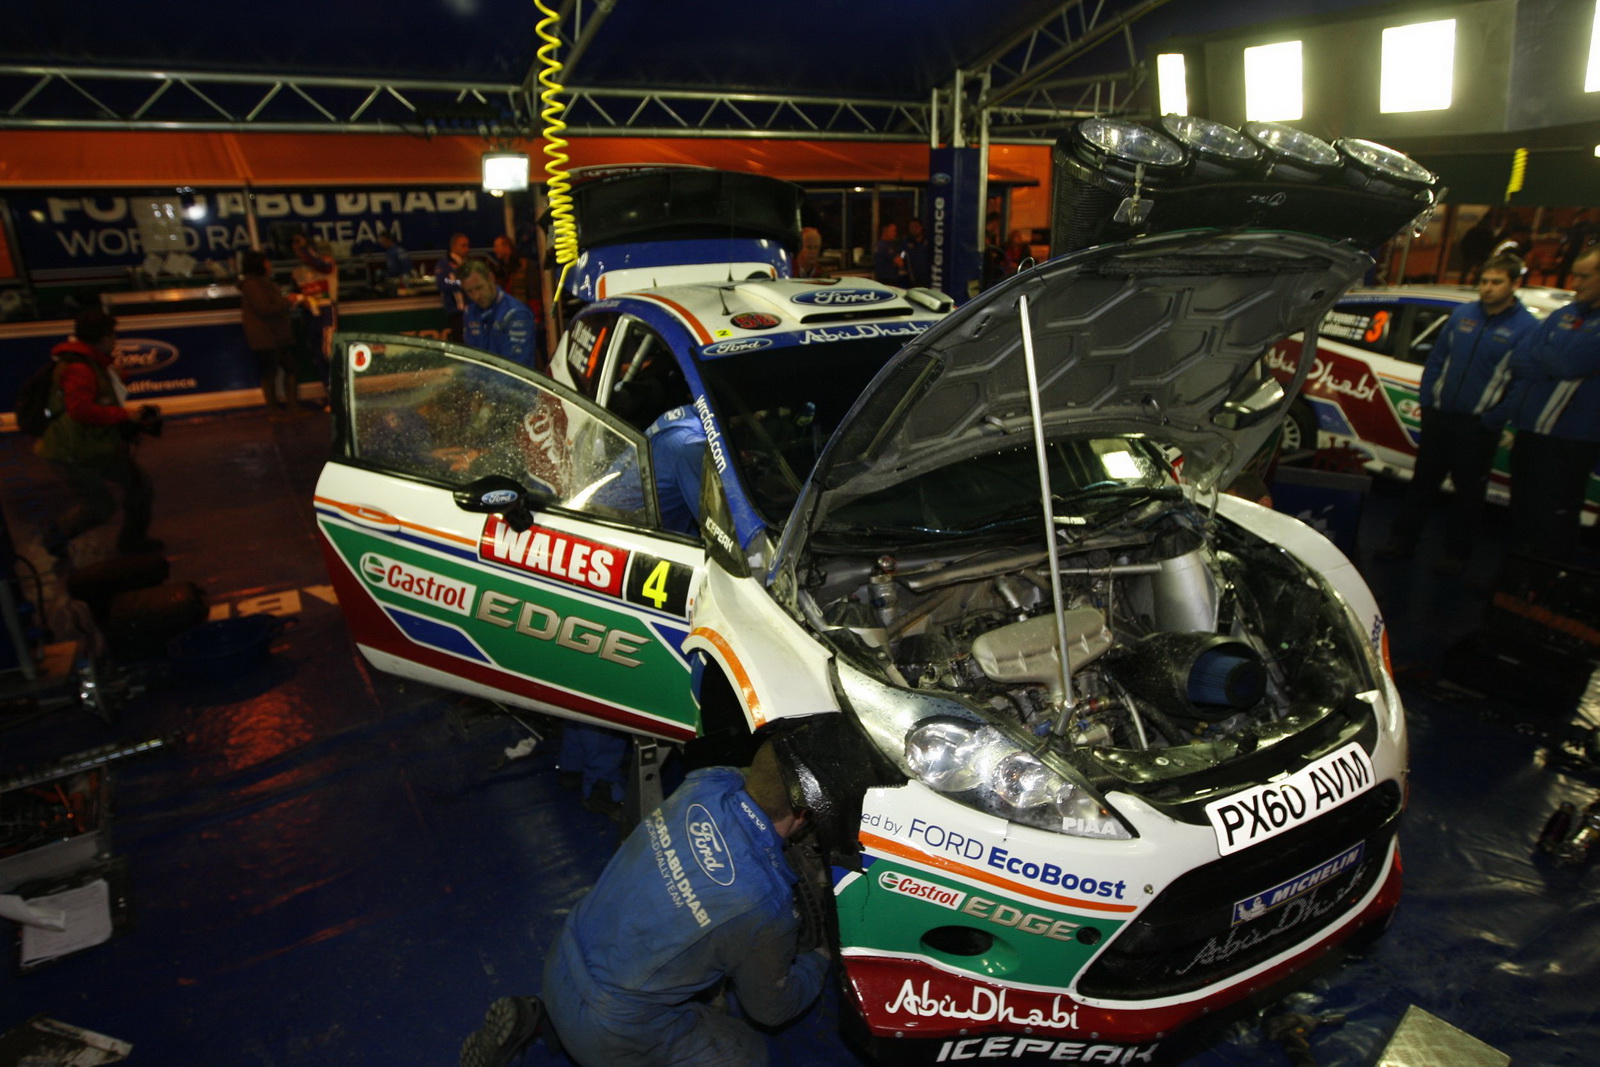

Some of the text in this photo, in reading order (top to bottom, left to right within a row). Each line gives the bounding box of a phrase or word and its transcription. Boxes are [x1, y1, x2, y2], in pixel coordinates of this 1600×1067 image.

[54, 223, 200, 258] WORD
[931, 197, 945, 290] ifference
[814, 290, 880, 304] Ford
[1365, 309, 1389, 343] 3
[716, 340, 761, 354] Ford
[696, 394, 728, 474] wrcford.com
[489, 490, 512, 503] Ford
[493, 521, 615, 589] WALES
[642, 560, 671, 610] 4
[386, 565, 467, 611] Castrol
[475, 589, 653, 669] EDGE
[740, 801, 767, 832] sparco
[1062, 816, 1117, 836] PIAA
[1217, 750, 1370, 847] PX60 AVM
[652, 807, 711, 928] FORD ABU DHABI
[689, 821, 724, 872] Ford
[883, 815, 903, 837] by
[908, 818, 984, 860] FORD
[988, 845, 1127, 901] EcoBoost
[654, 849, 671, 879] RALLY
[665, 877, 684, 908] TEAM
[1270, 848, 1360, 906] MICHELIN
[898, 877, 1081, 943] Castrol EDGE
